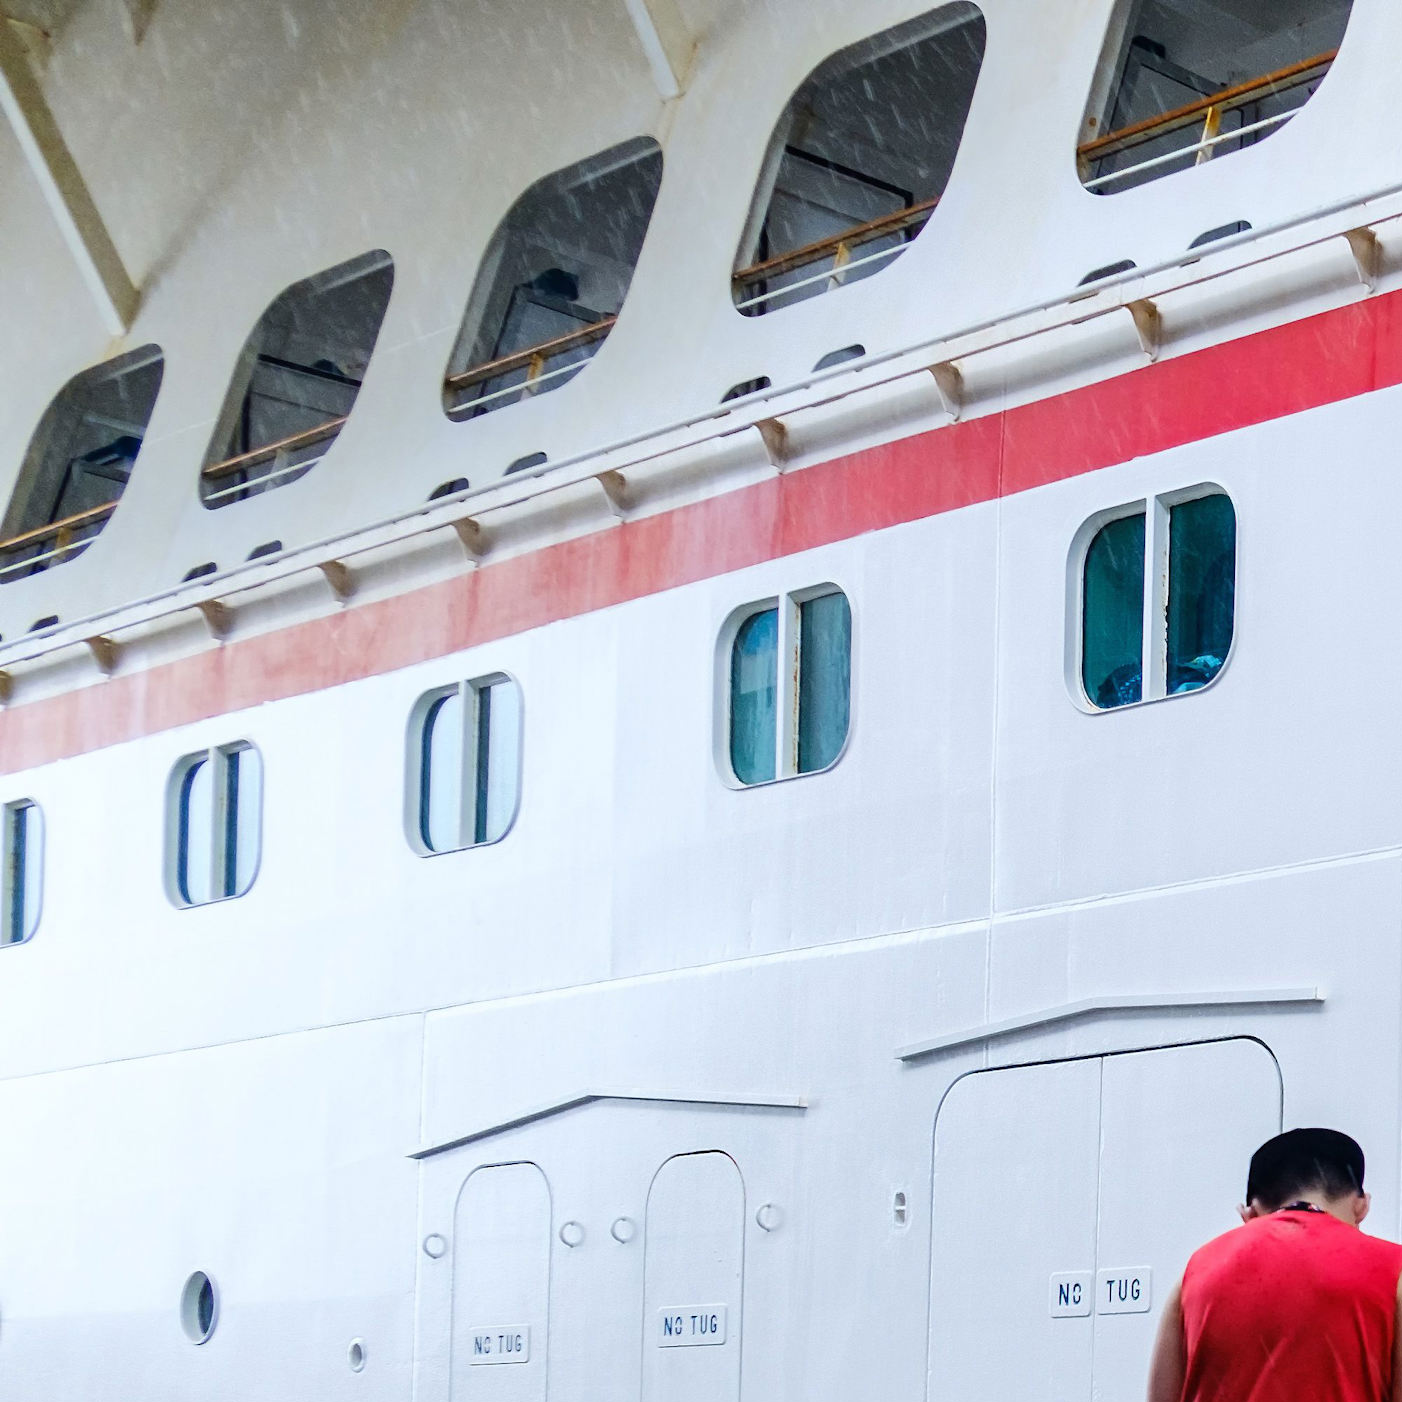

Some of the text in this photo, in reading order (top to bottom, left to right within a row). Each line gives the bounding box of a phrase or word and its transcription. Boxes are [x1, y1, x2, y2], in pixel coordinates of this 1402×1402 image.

[1058, 1278, 1141, 1305] NO TUG
[663, 1314, 718, 1336] NO TUG
[474, 1334, 522, 1354] NO TUG
